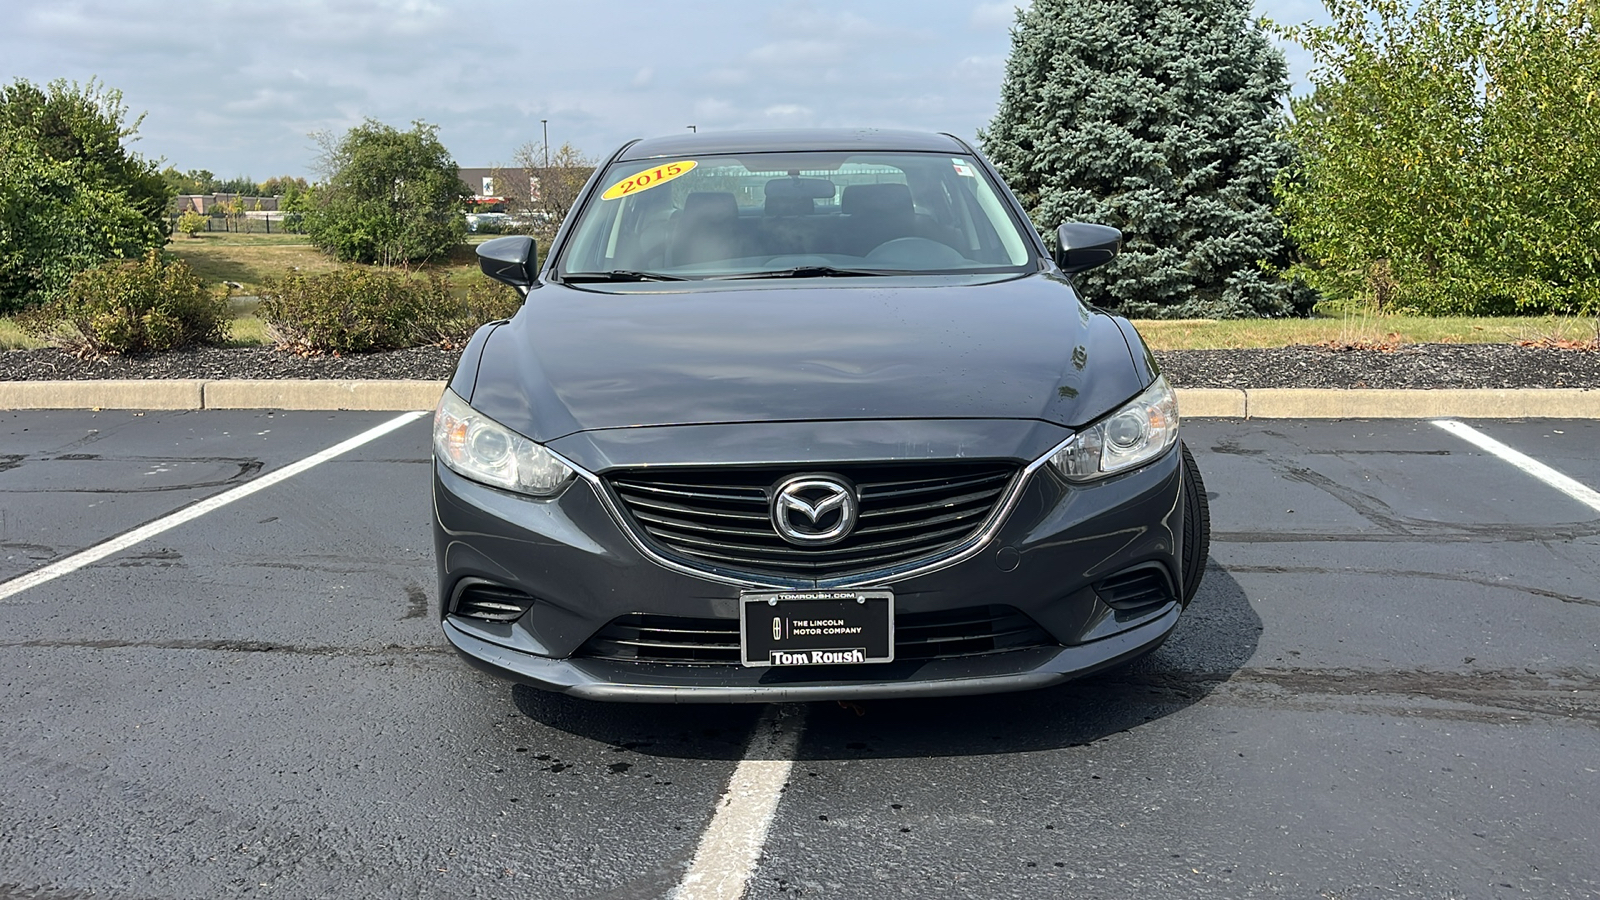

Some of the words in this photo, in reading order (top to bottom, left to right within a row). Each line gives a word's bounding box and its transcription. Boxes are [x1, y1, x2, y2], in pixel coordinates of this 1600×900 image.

[620, 164, 681, 194] 2015
[778, 592, 855, 600] TOMROUSH.COM
[809, 619, 844, 627] LINCOLN
[823, 627, 862, 635] COMPANY
[771, 651, 810, 665] Tom
[811, 649, 864, 664] Roush
